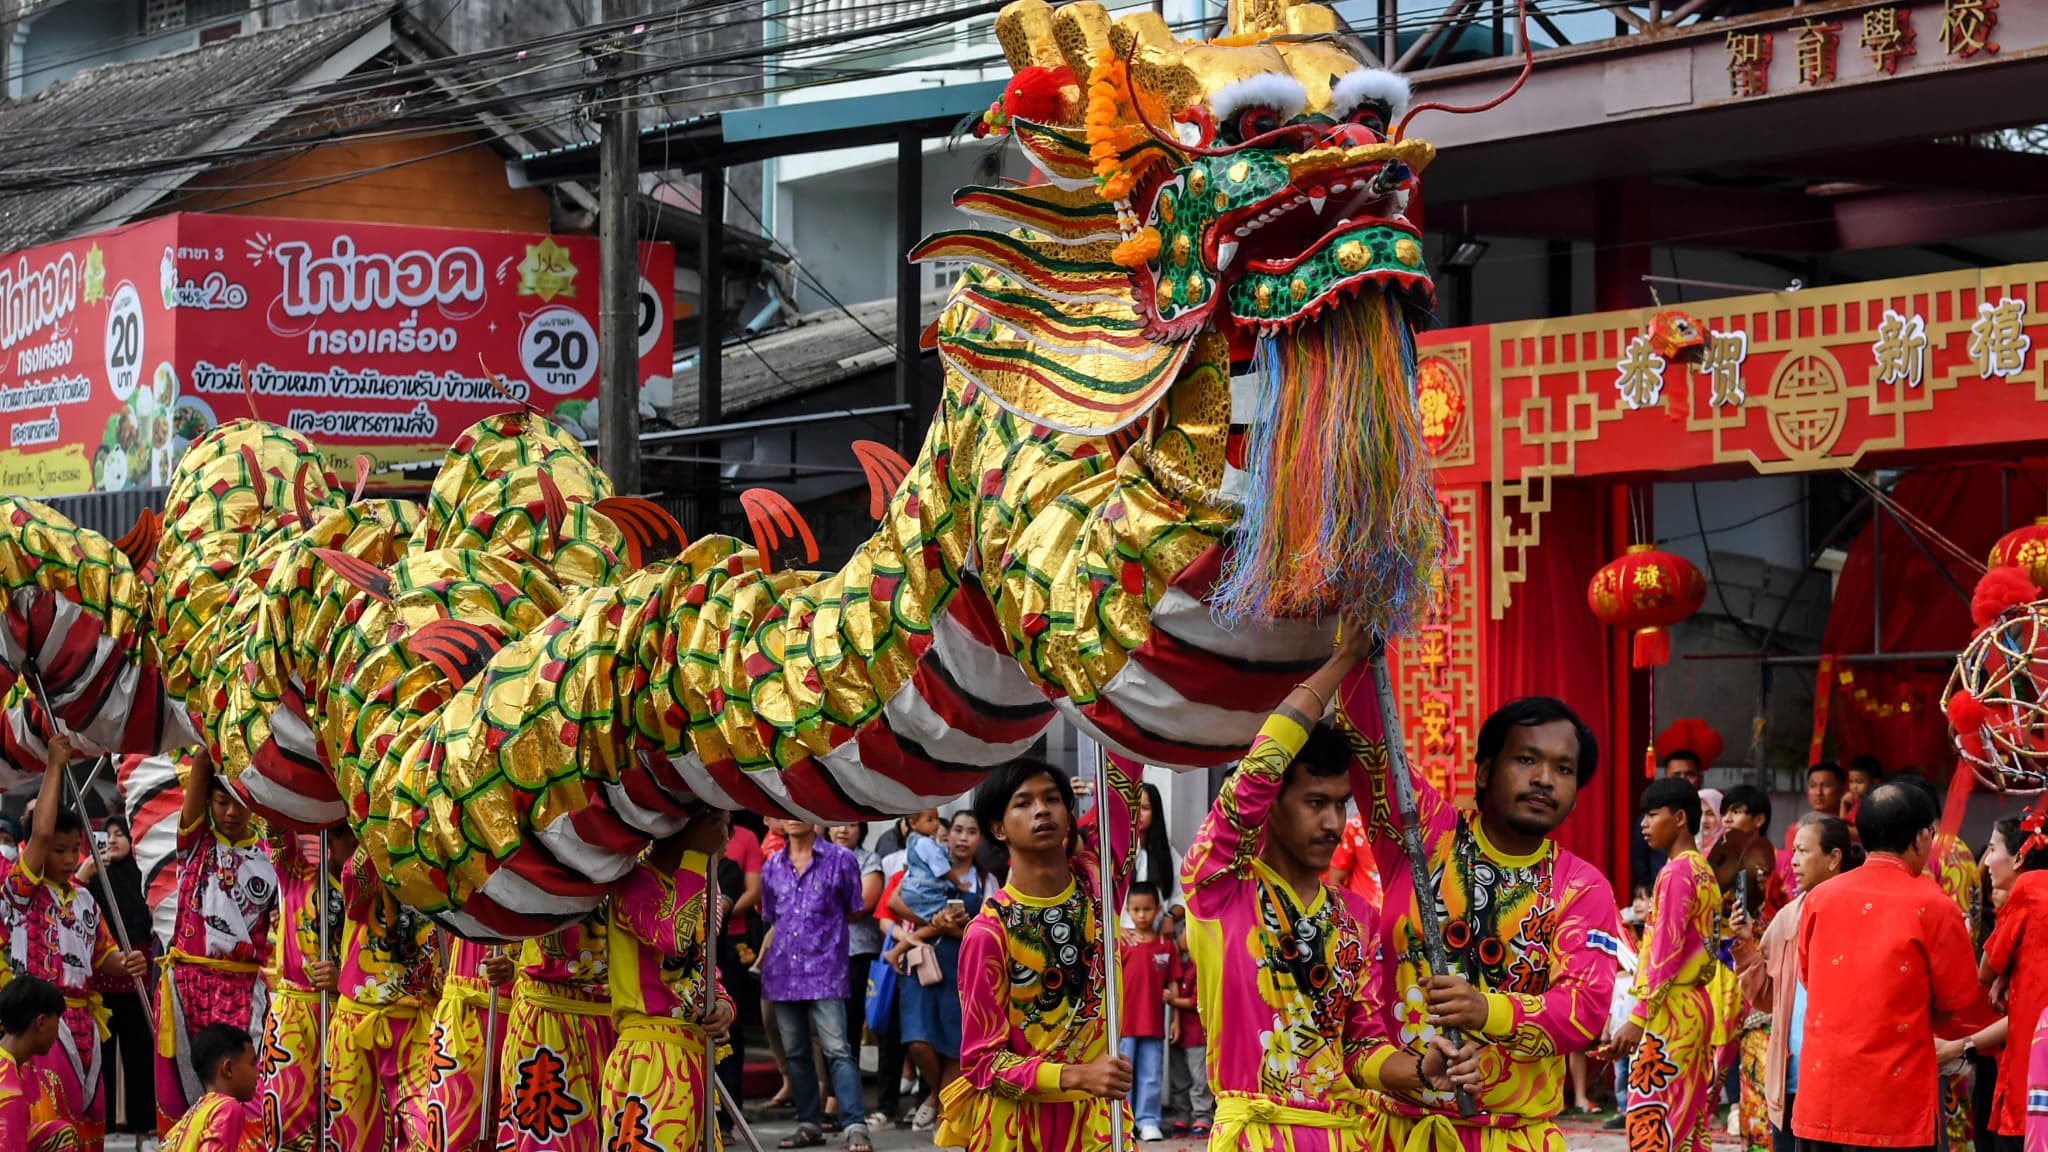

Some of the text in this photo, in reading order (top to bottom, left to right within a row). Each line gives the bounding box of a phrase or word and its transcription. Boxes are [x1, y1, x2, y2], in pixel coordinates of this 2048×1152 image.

[178, 247, 224, 261] สาขา 3
[275, 235, 484, 317] ไก่ทอด
[0, 252, 77, 350] ไก่ทอด
[111, 312, 138, 367] 20
[307, 309, 457, 354] ทรงเครื่อง
[533, 330, 588, 370] 20
[117, 371, 132, 388] บาท
[256, 364, 326, 392] ข้าวหมก
[330, 367, 441, 398] ข้าวมันอาหรับ
[547, 372, 576, 385] บาท
[289, 405, 435, 436] และอาหารตามสั่ง
[513, 1047, 584, 1142] 泰
